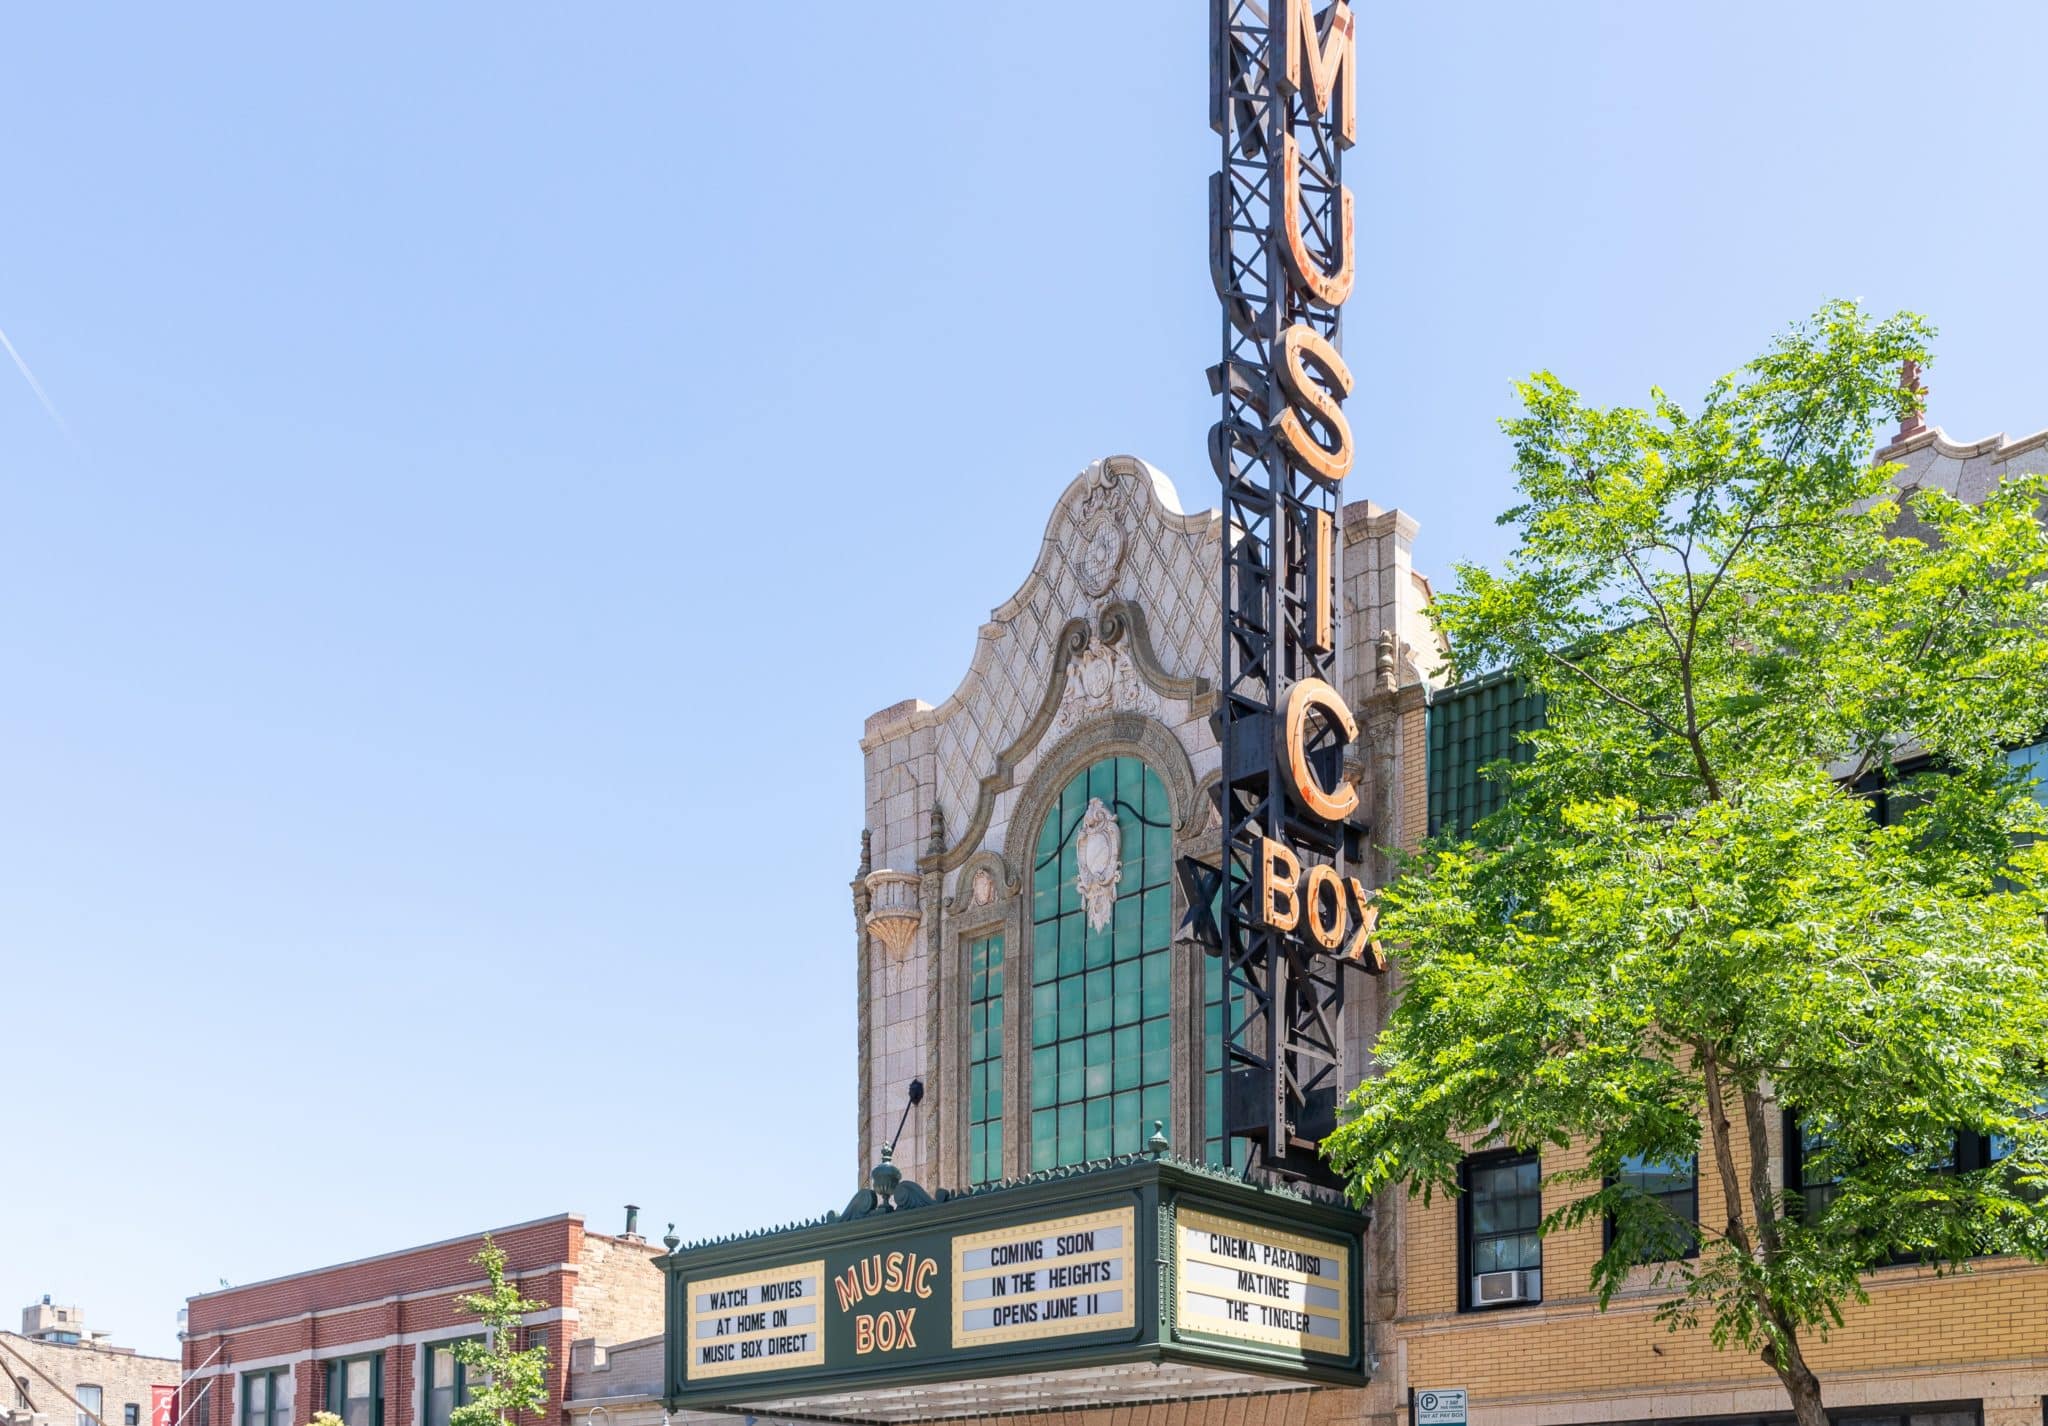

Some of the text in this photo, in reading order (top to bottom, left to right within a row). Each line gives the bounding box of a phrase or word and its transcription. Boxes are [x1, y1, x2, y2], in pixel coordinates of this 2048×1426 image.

[1275, 0, 1359, 821] MUSIC
[1262, 836, 1388, 971] BOX
[991, 1231, 1094, 1266] COMING SOON
[1210, 1233, 1321, 1276] CINEMA PARADISO
[710, 1280, 803, 1310] WATCH MOVIES
[834, 1251, 938, 1313] MUSIC
[992, 1260, 1111, 1297] IN THE HEIGHTS
[1237, 1269, 1290, 1299] MATINEE
[716, 1309, 788, 1336] AT HOME ON
[993, 1302, 1038, 1327] OPENS
[1042, 1296, 1078, 1321] JUNE
[1226, 1299, 1310, 1334] THE TINGLER
[856, 1307, 917, 1354] BOX
[702, 1333, 808, 1364] MUSIC BOX DIRECT
